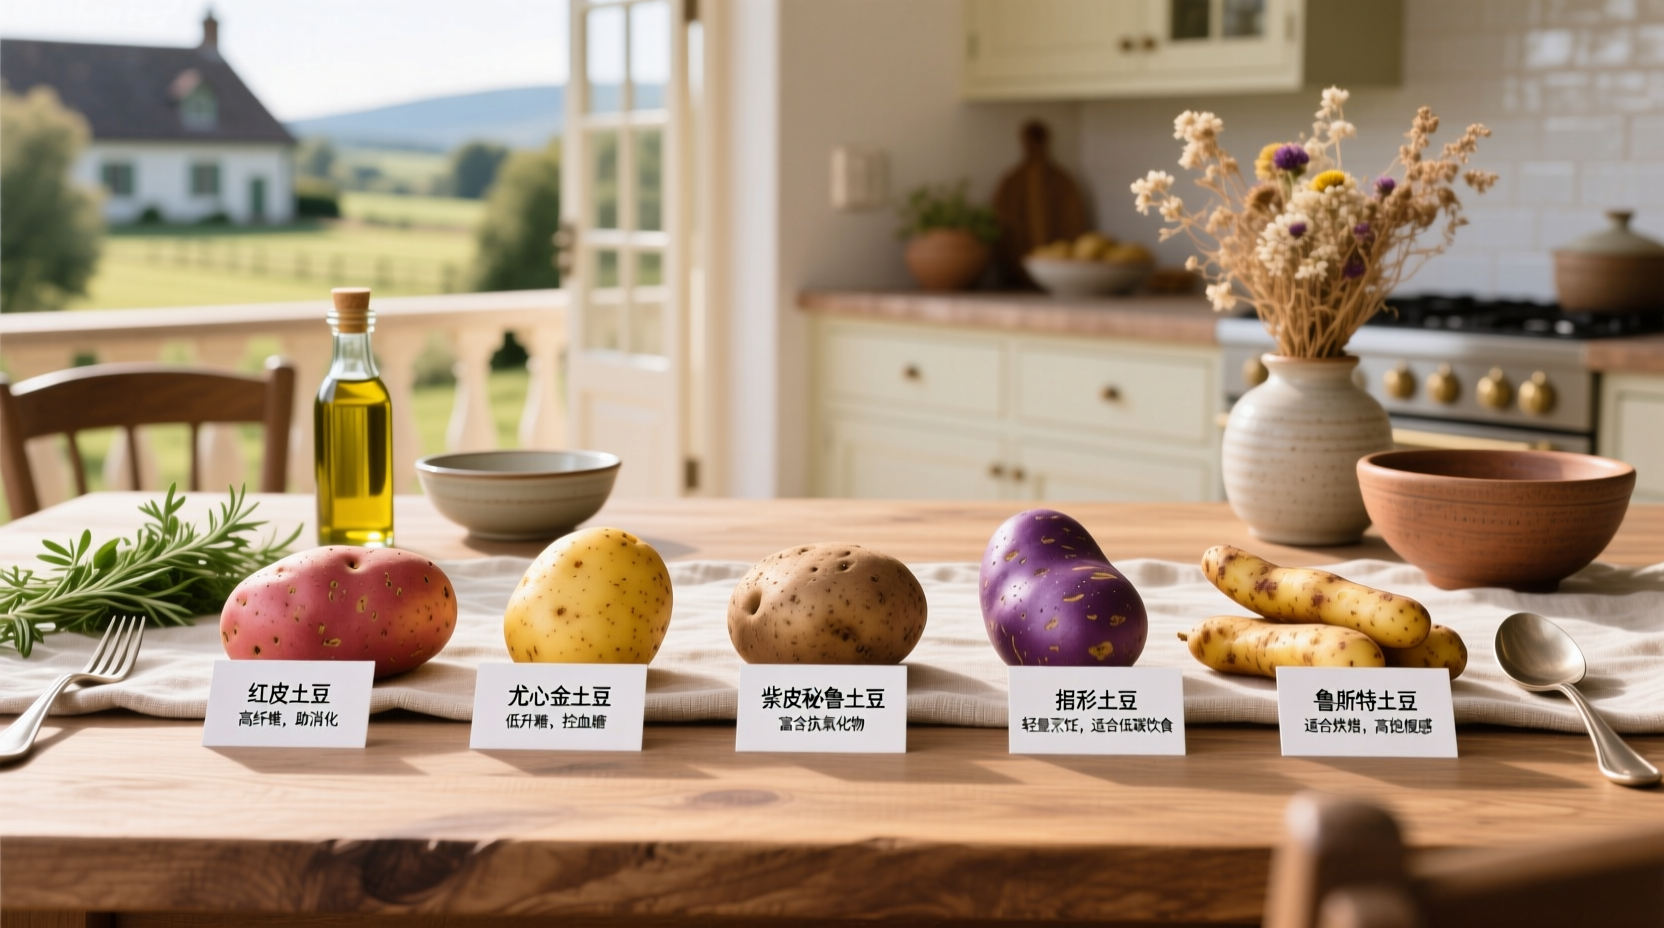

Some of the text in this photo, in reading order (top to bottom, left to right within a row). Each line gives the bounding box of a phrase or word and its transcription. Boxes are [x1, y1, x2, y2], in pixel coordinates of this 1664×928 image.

[248, 682, 330, 705] 红皮土豆
[508, 684, 611, 706] 尤心金土豆
[761, 686, 885, 709] 紫皮秘鲁土豆
[1313, 689, 1417, 712] 鲁斯特土豆
